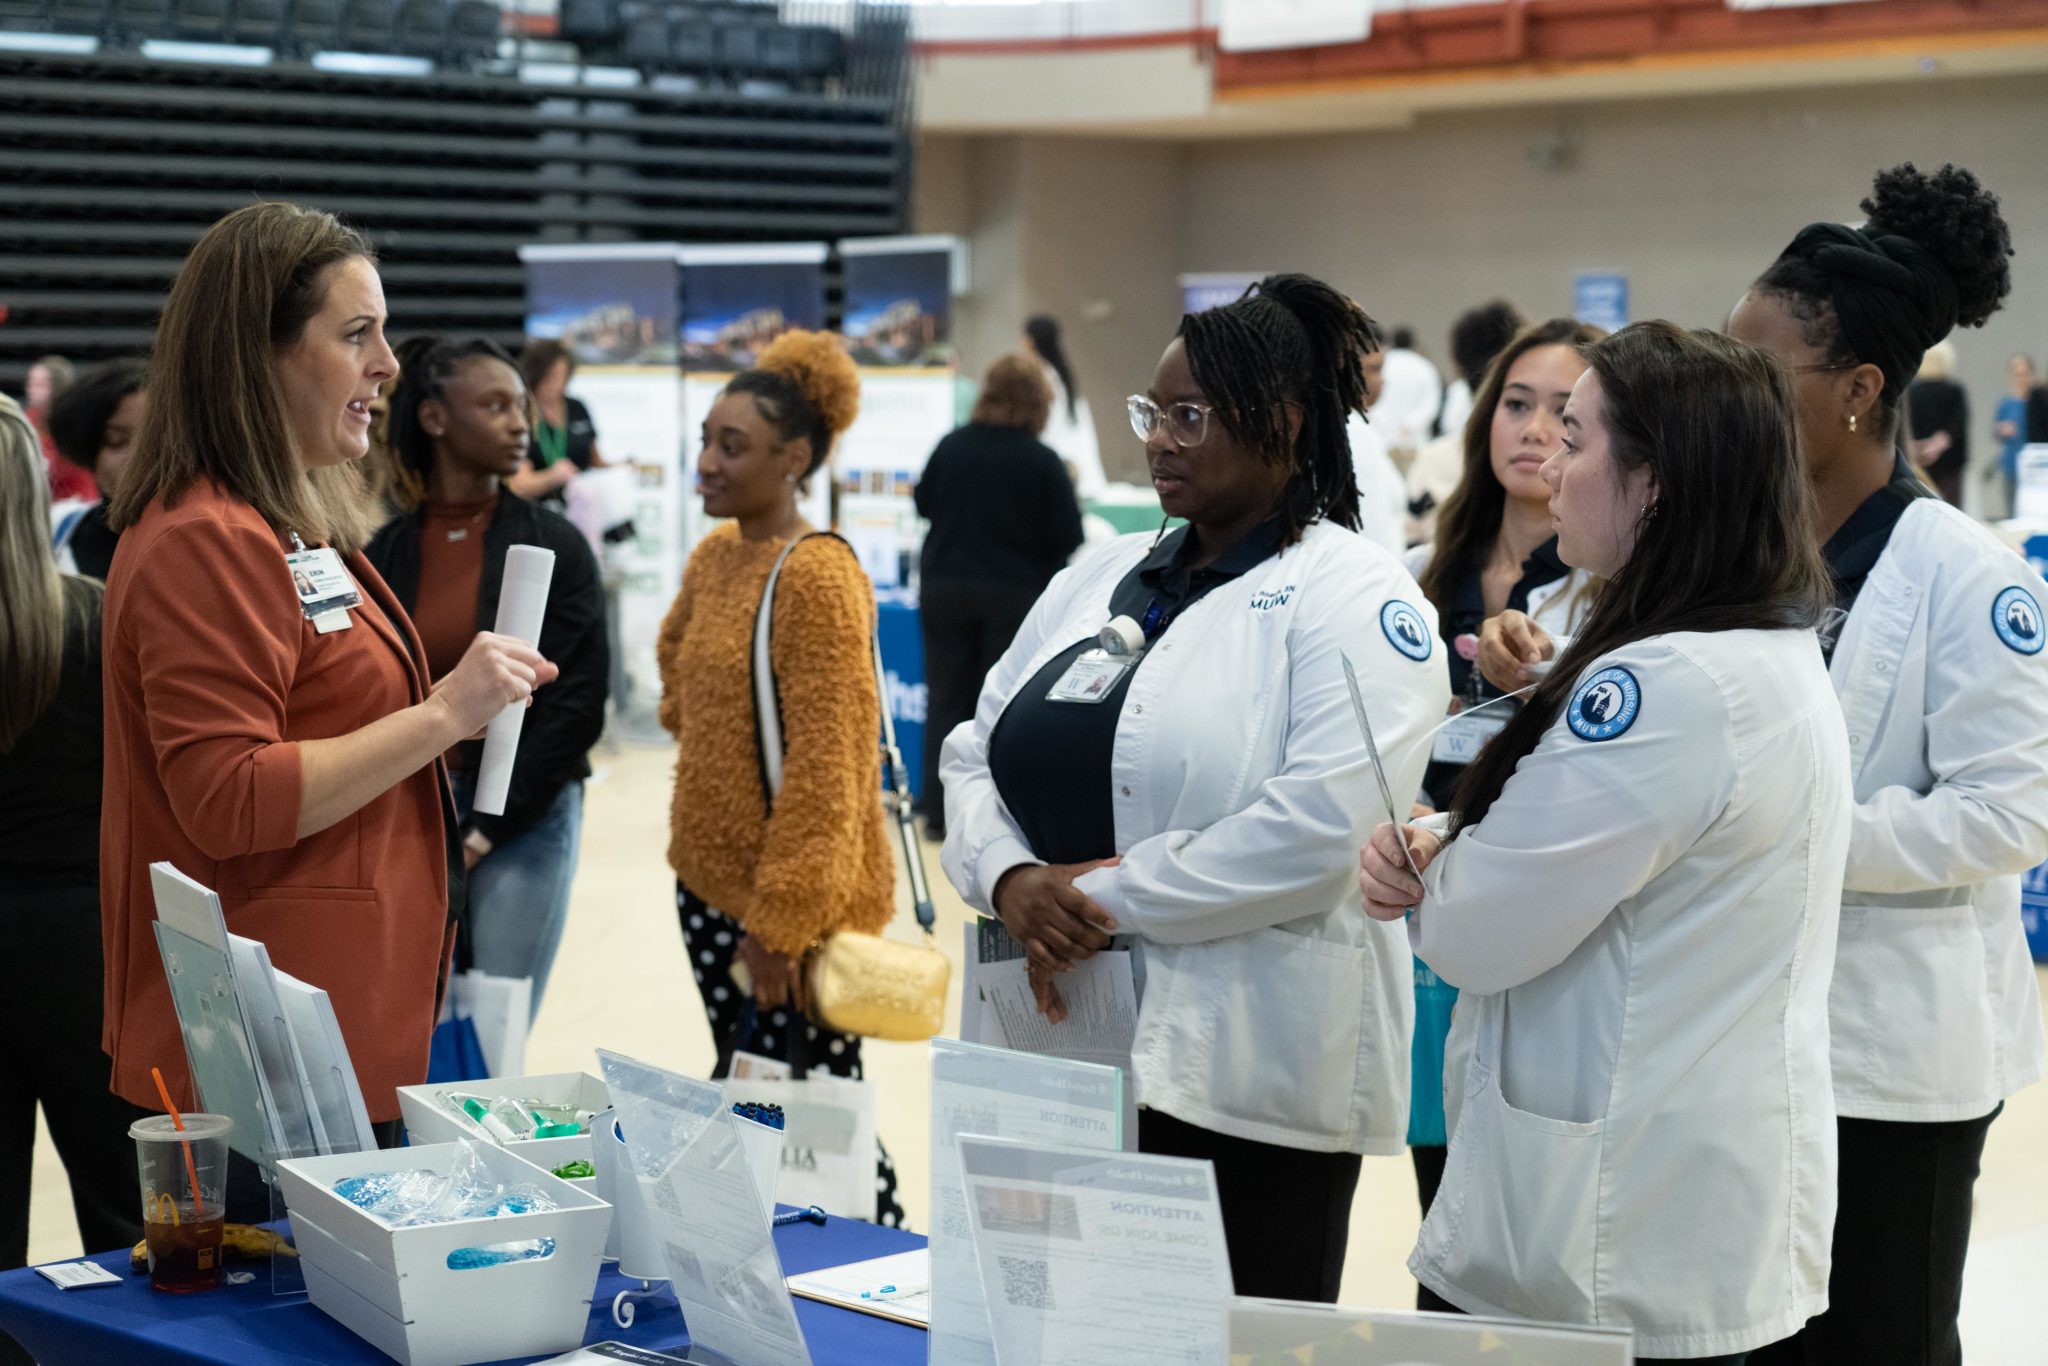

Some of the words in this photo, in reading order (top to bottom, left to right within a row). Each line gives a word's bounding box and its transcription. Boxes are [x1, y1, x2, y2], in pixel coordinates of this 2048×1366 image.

[308, 569, 325, 577] ERIN
[1249, 594, 1289, 610] MUW
[1613, 671, 1626, 681] OF
[1576, 671, 1611, 702] COLLEGE
[1616, 681, 1635, 725] NURSING
[1574, 718, 1599, 735] MUW
